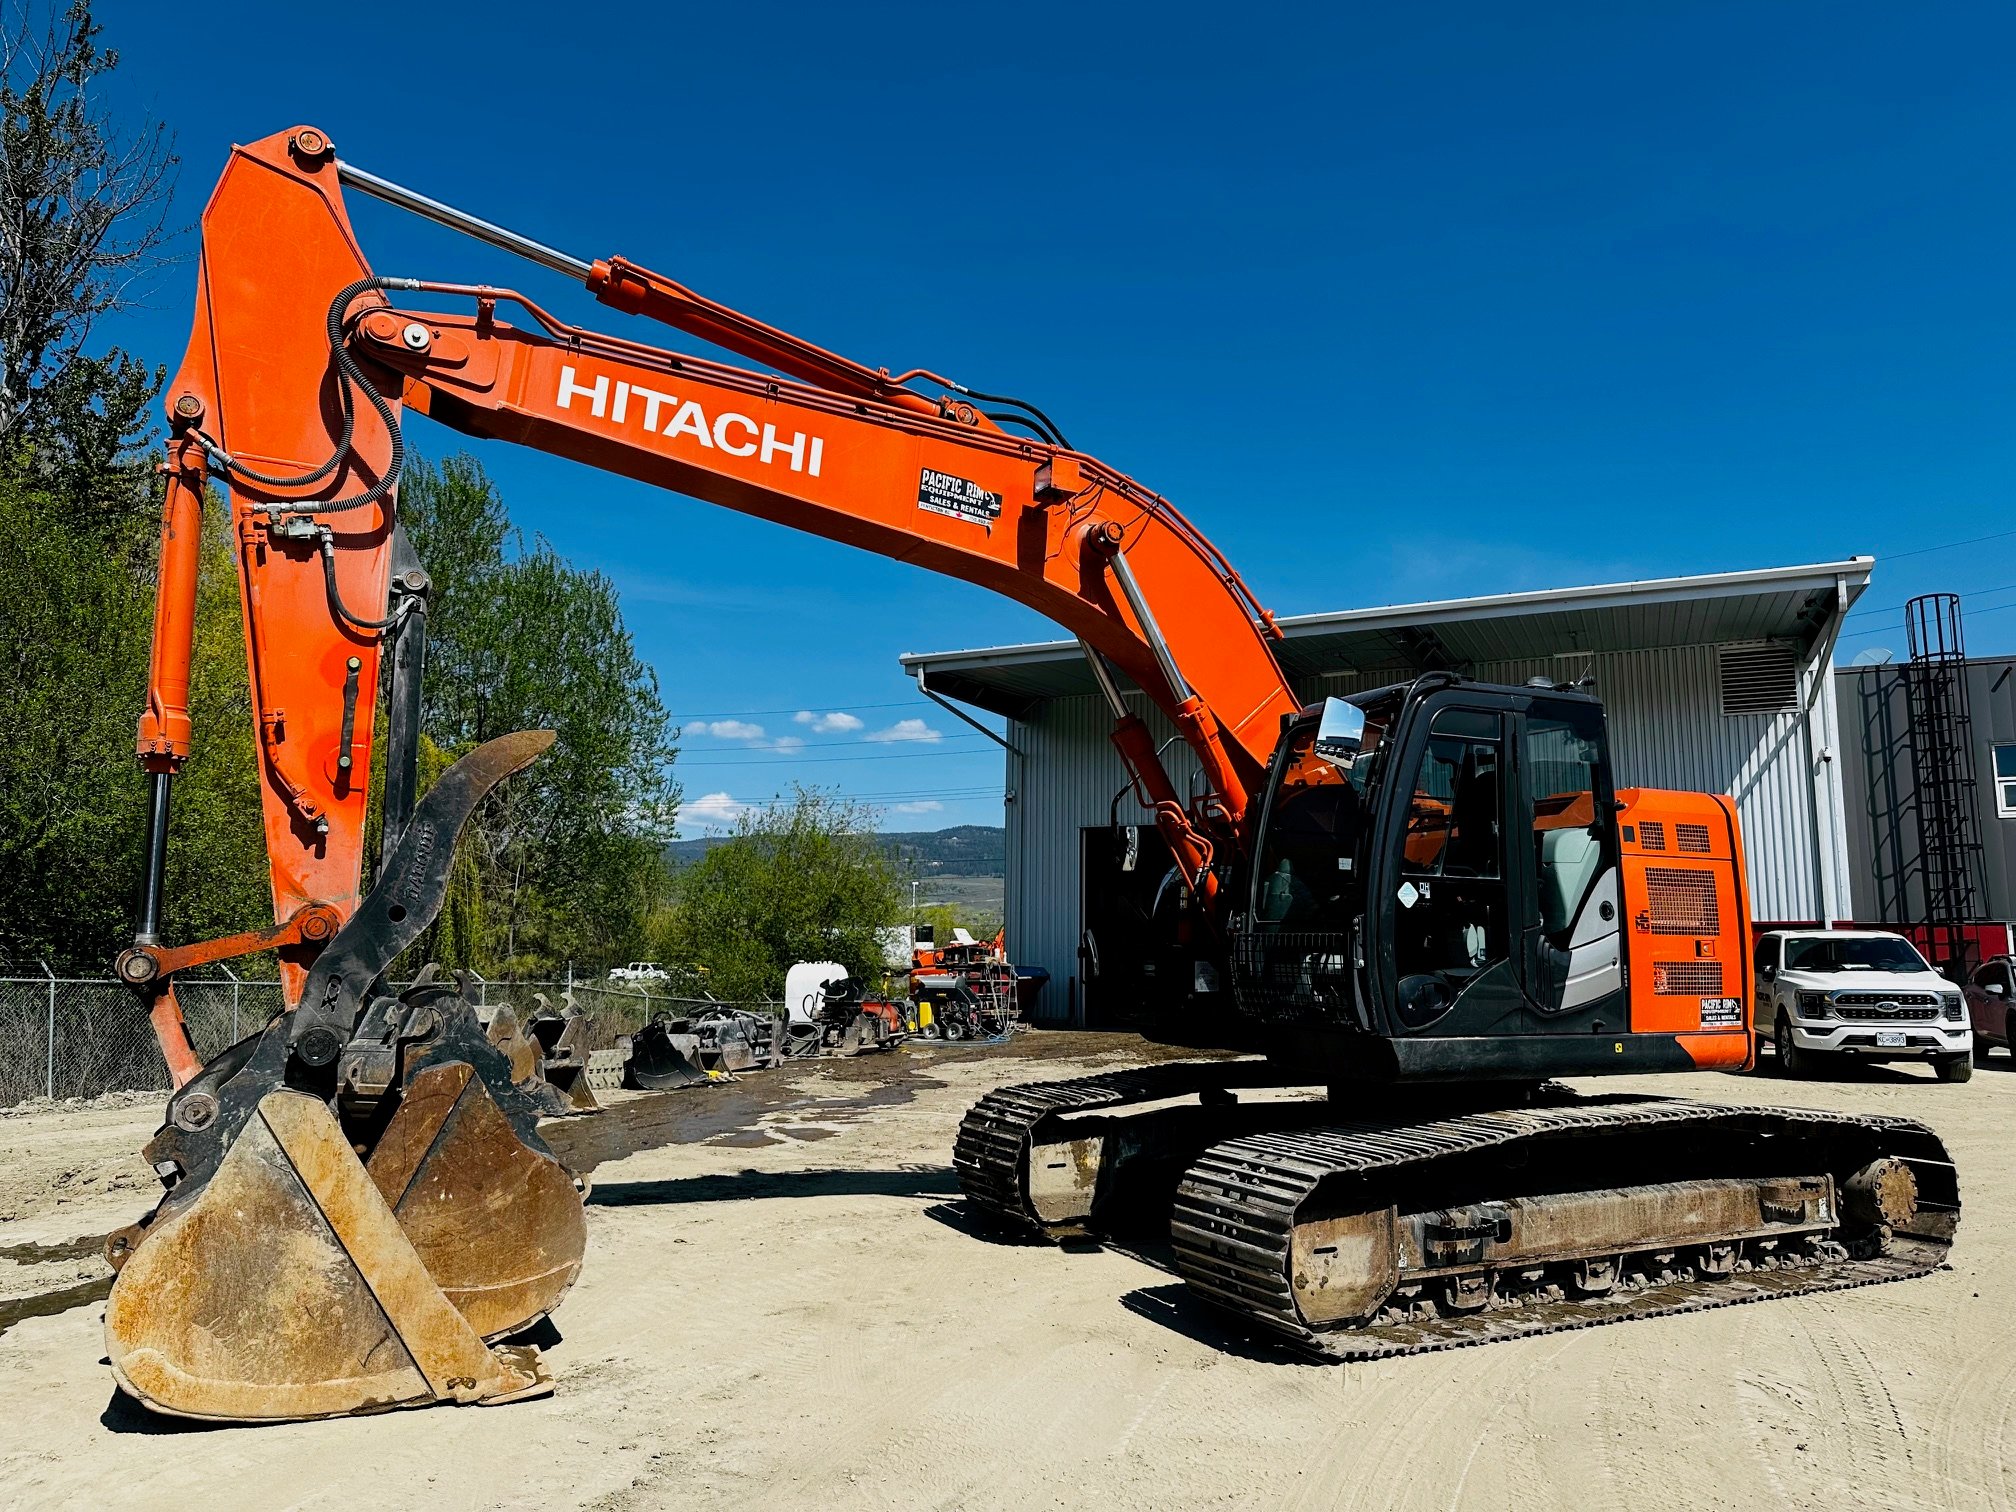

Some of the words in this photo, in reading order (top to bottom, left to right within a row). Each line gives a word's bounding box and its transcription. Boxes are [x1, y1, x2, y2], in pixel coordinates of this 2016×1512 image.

[556, 365, 824, 477] HITACHI
[920, 484, 983, 506] EQUIPMENT
[921, 469, 962, 494] PACIFIC
[966, 481, 984, 500] RIM
[929, 496, 951, 508] SALES
[952, 502, 959, 510] &
[960, 504, 991, 517] RENTALS
[1701, 998, 1721, 1009] PACIFIC
